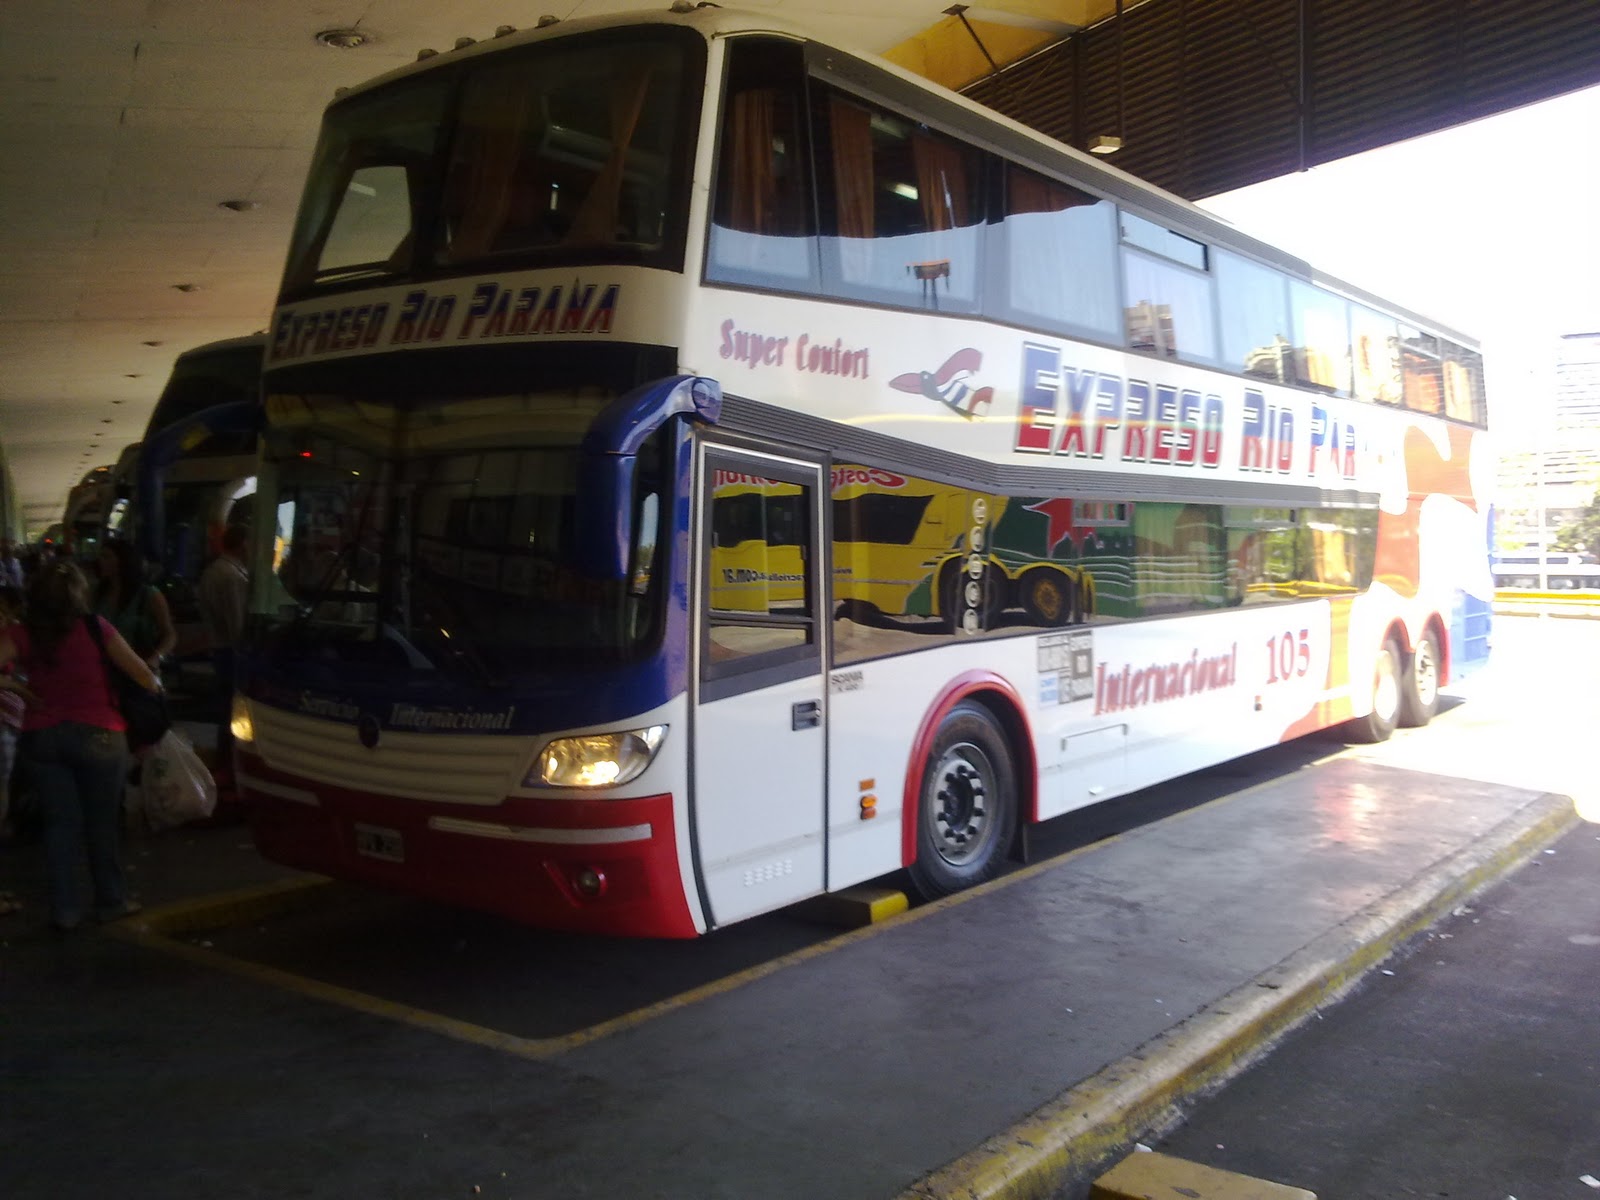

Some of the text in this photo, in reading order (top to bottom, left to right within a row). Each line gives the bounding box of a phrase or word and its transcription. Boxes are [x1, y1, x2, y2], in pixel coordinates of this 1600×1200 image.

[720, 318, 788, 369] Super
[1013, 341, 1224, 469] EXPRESO
[1239, 387, 1294, 475] RIO
[1094, 642, 1238, 716] Internacional
[1265, 629, 1311, 685] 105
[388, 702, 516, 729] Internacional
